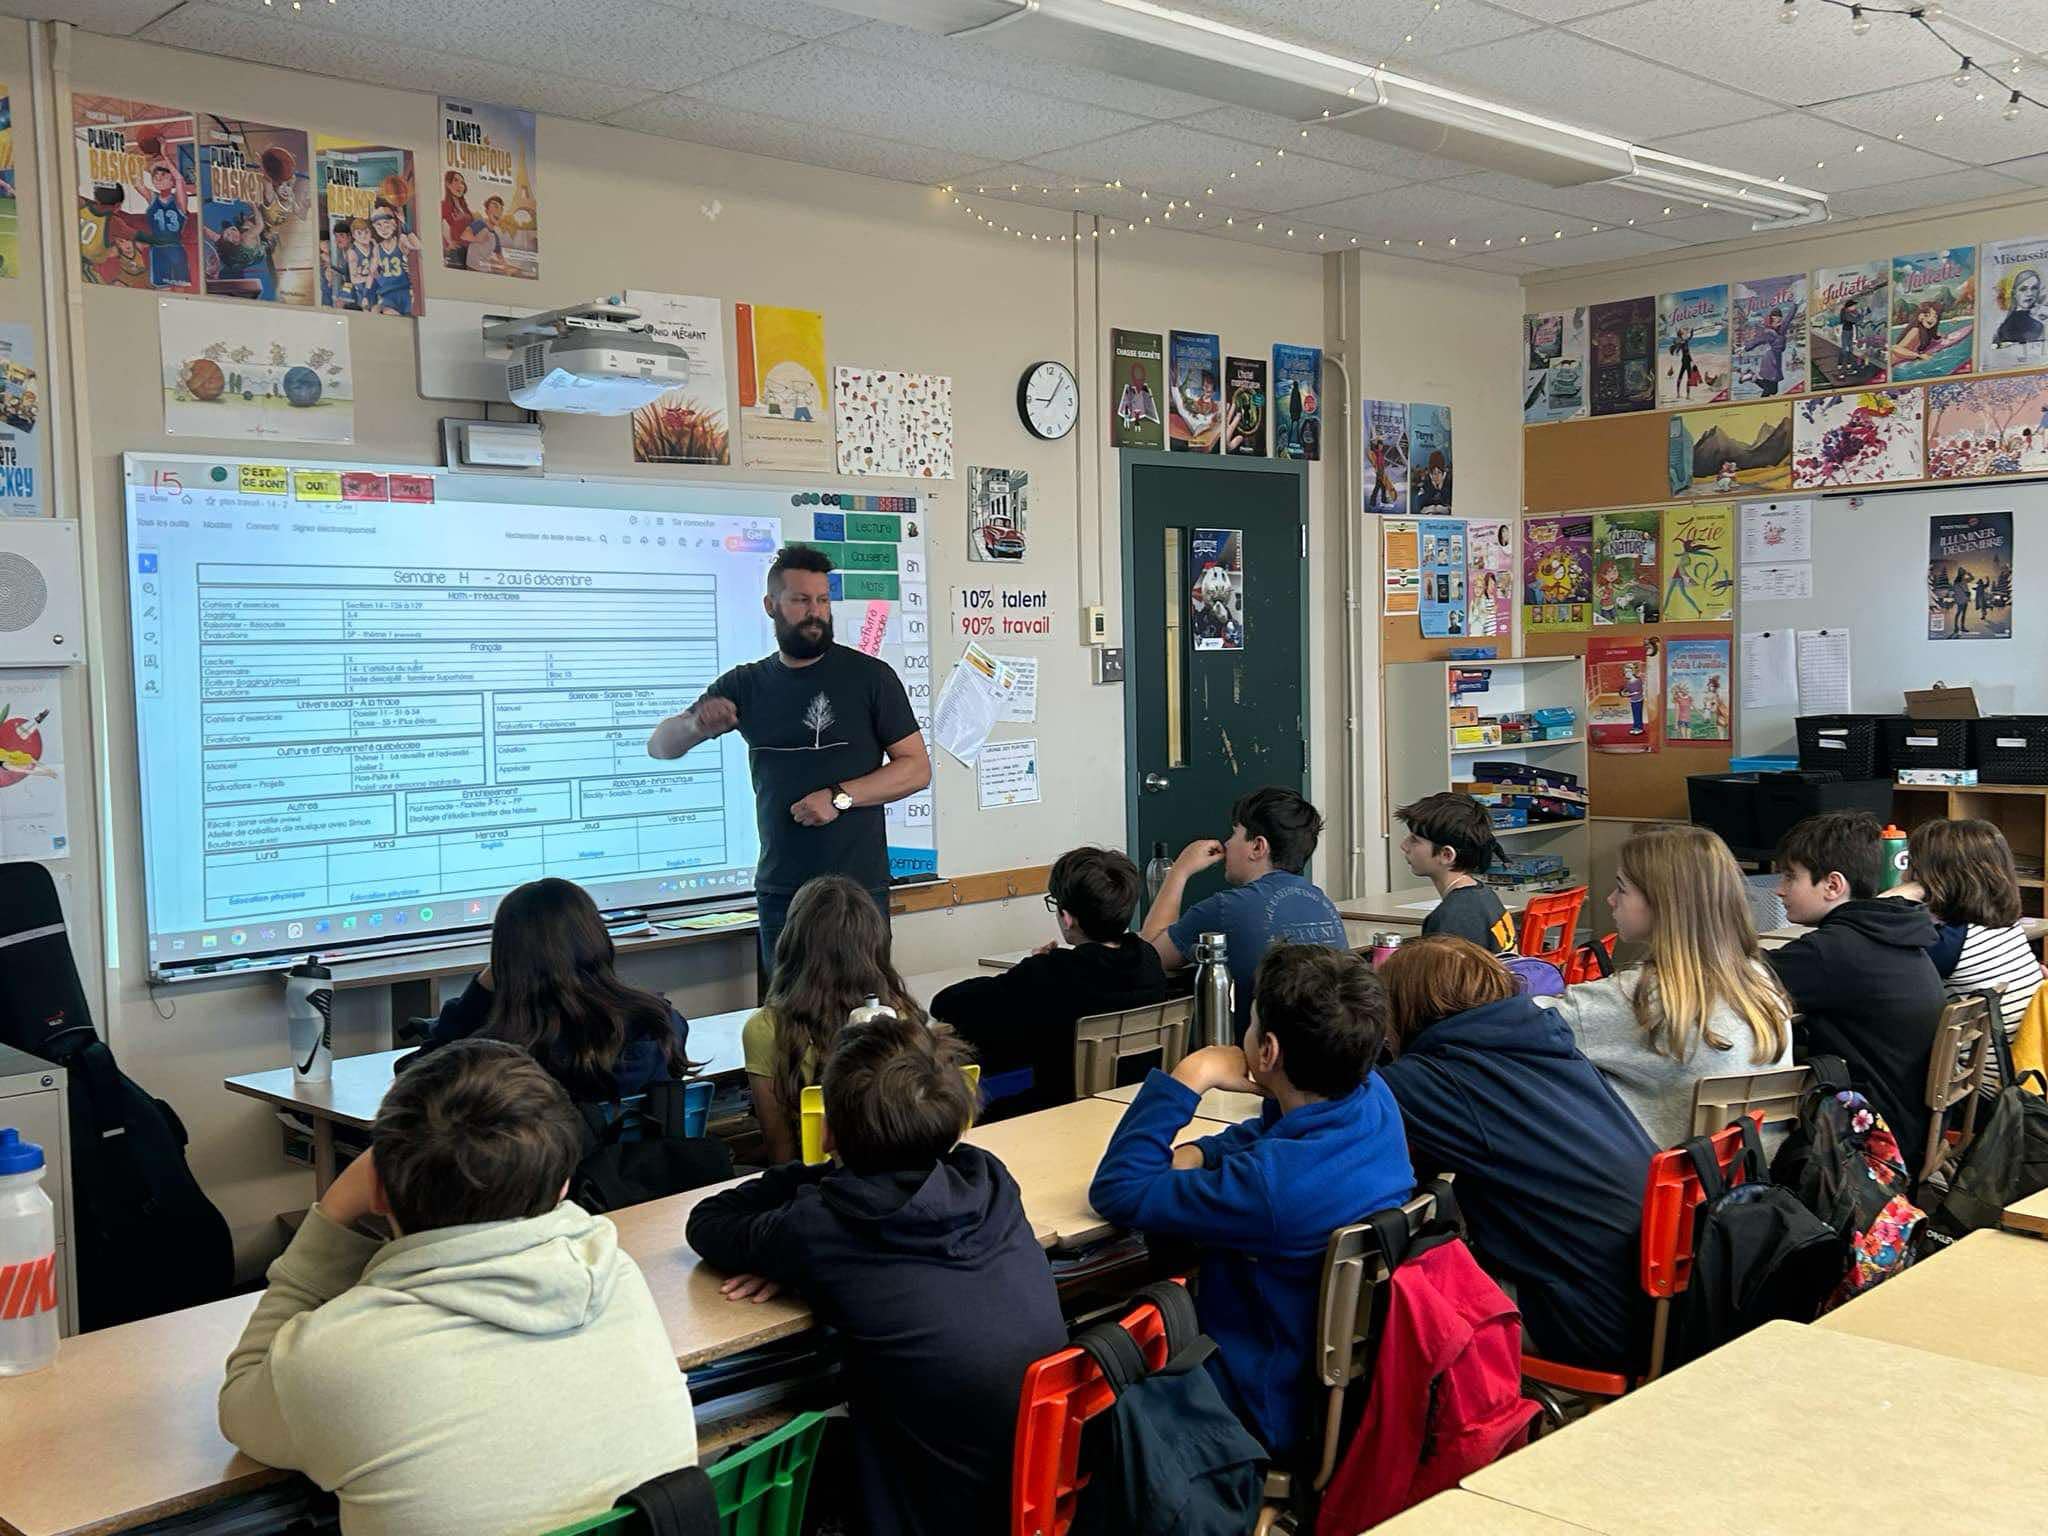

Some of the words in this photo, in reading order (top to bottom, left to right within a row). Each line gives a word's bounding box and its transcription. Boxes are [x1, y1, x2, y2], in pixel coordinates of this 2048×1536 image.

[90, 151, 145, 185] BASKET
[153, 209, 180, 232] 13
[382, 257, 401, 276] 13
[1822, 277, 1874, 304] Juliette
[1046, 366, 1054, 375] 12
[1673, 518, 1724, 542] Zazie
[907, 559, 920, 573] 8h
[394, 570, 446, 584] Semaine
[497, 573, 505, 585] 2
[507, 576, 522, 586] au
[524, 574, 532, 586] 6
[534, 573, 592, 587] décembre
[908, 592, 922, 606] 9h
[961, 590, 994, 608] 10%
[1002, 590, 1047, 609] talent
[962, 617, 995, 635] 90%
[1003, 616, 1050, 635] travail
[255, 851, 279, 860] Lundi
[373, 840, 396, 849] Mardi
